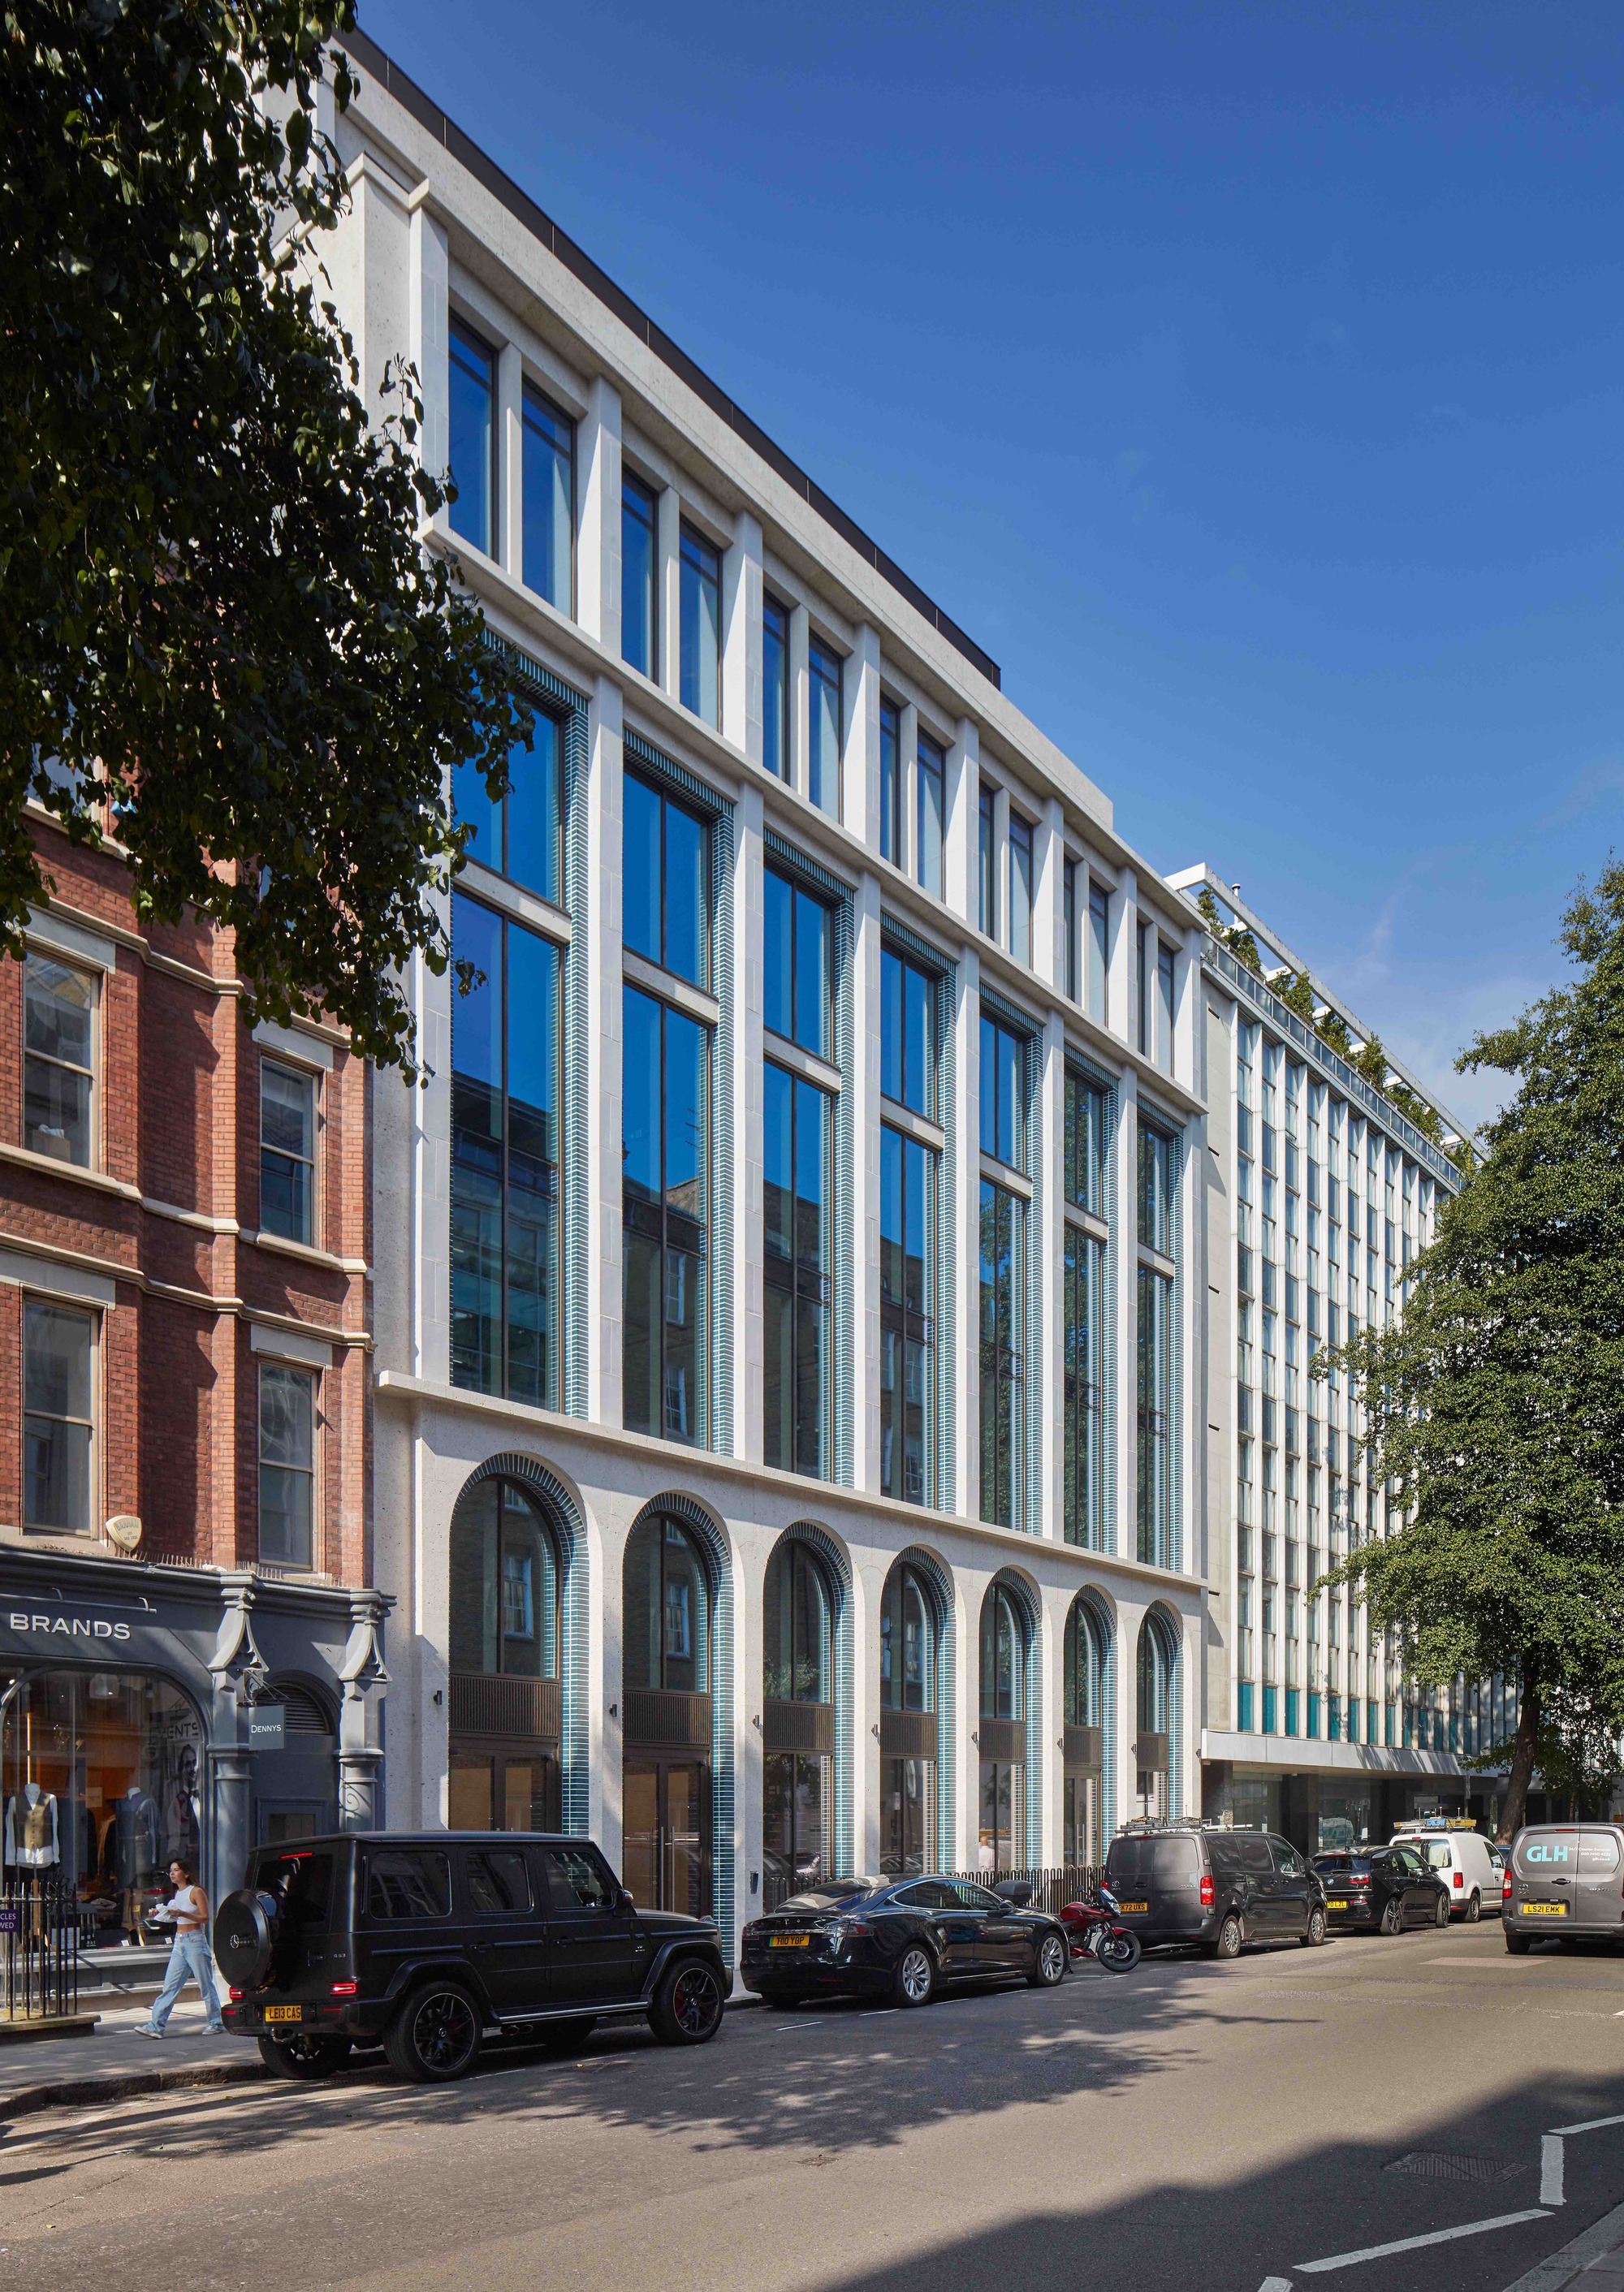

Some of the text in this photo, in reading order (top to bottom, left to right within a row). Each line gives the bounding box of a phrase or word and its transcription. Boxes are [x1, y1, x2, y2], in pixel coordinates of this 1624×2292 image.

[10, 1612, 131, 1640] BRANDS
[1527, 1845, 1568, 1862] GLH
[270, 2007, 300, 2019] LE13 CAS
